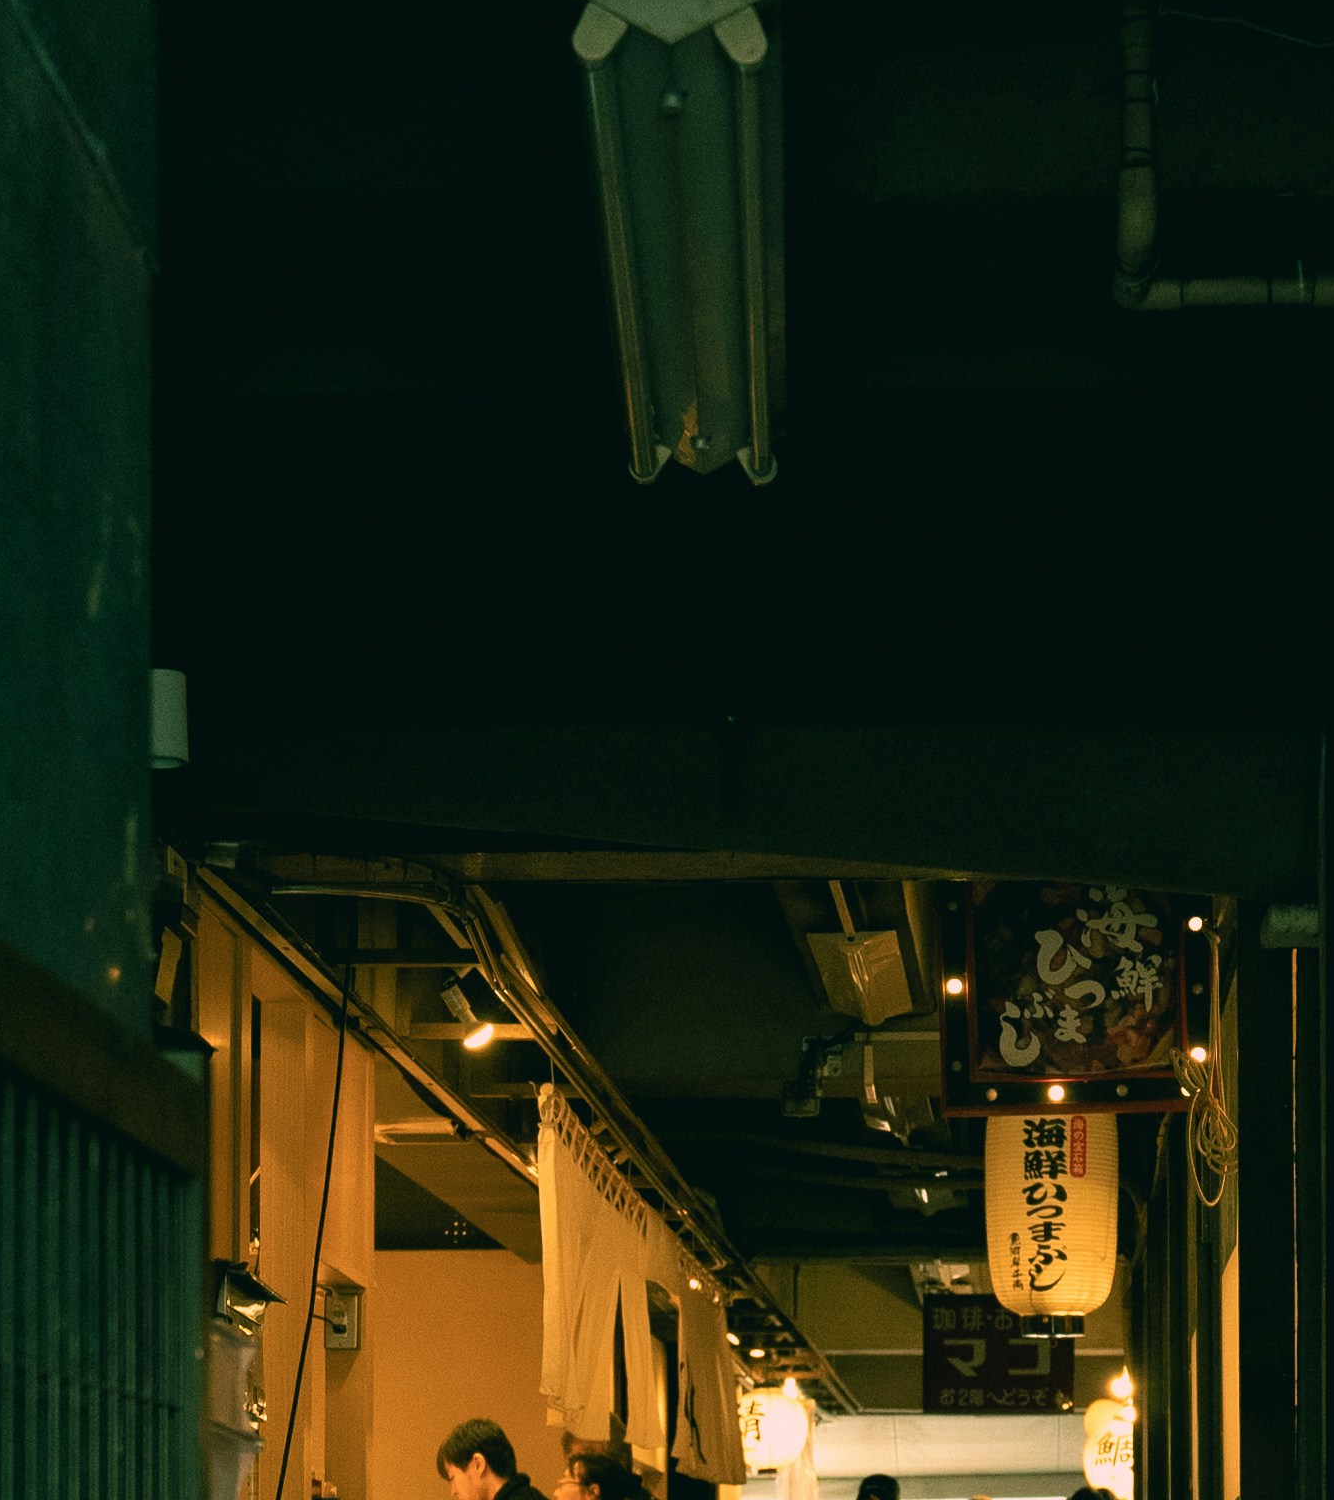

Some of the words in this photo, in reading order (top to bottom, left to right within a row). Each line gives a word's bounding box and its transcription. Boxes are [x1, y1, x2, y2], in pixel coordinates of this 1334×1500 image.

[1021, 1117, 1068, 1292] 海鮮ひつまぶし
[932, 1307, 1015, 1331] 珈琲・お
[943, 1338, 1051, 1377] マコ
[939, 1388, 1049, 1406] お2階へどうぞ
